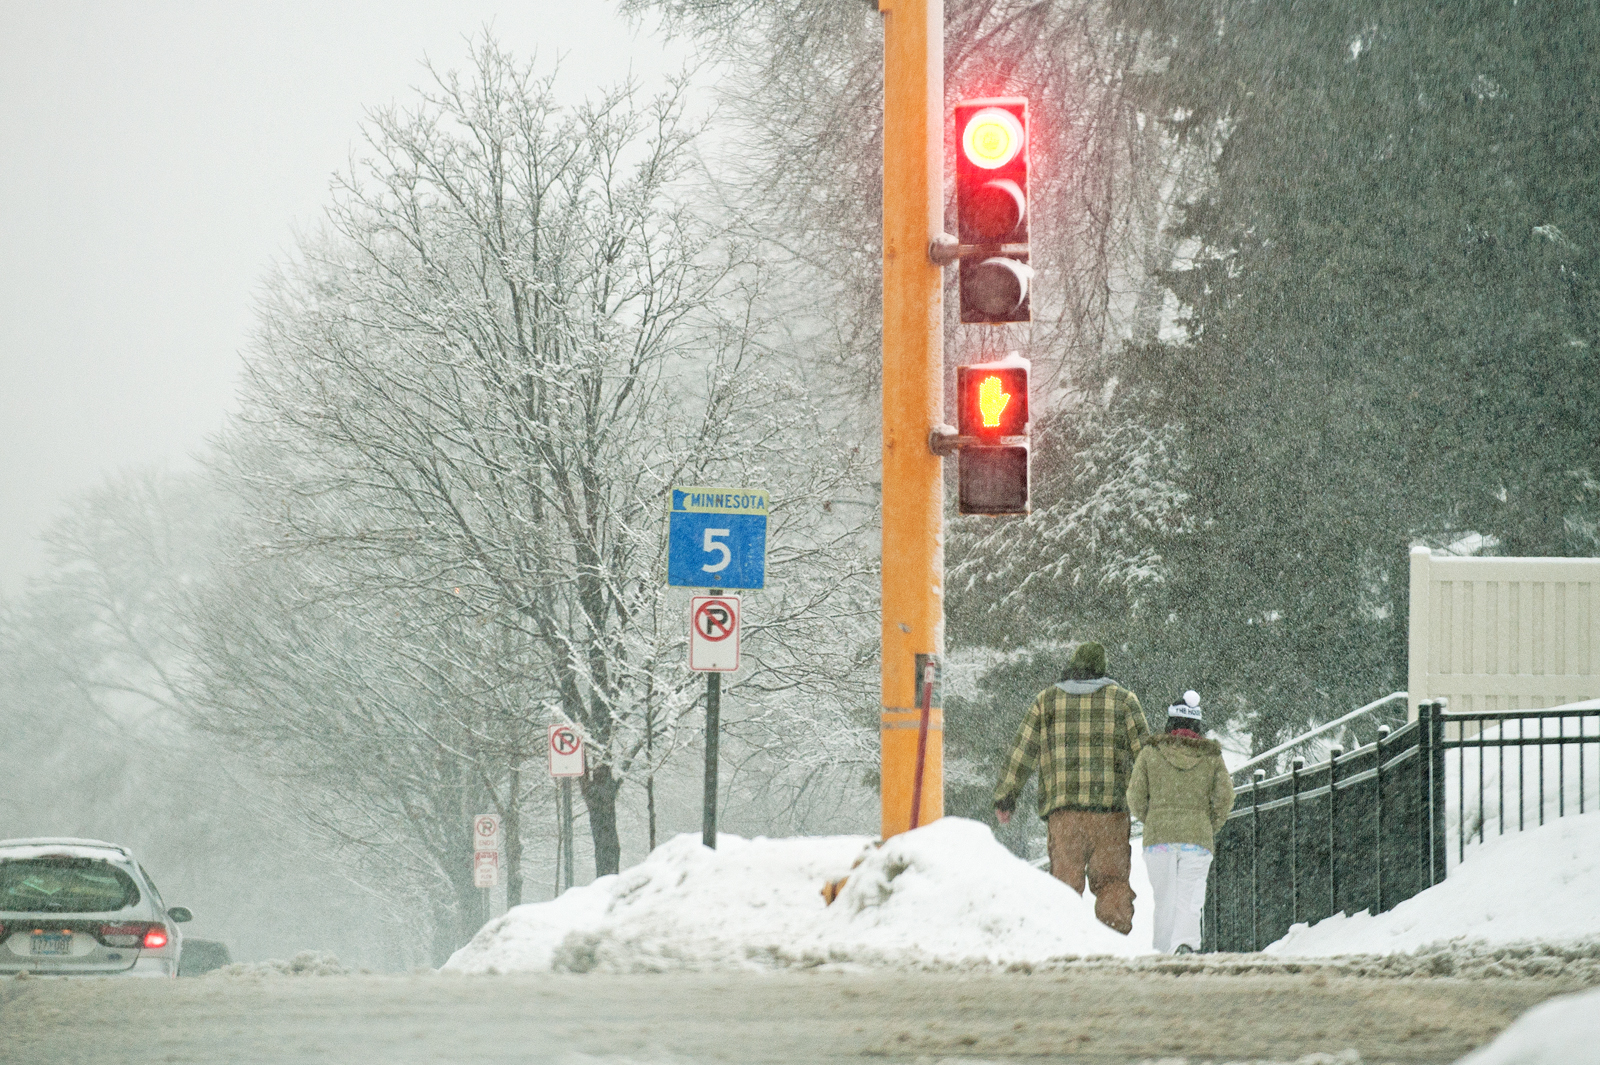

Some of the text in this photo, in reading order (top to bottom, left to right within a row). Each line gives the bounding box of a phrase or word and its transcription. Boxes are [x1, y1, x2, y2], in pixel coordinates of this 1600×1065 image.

[691, 493, 765, 510] MINNESOTA
[701, 528, 732, 573] 5
[706, 608, 728, 635] P
[560, 732, 575, 751] P
